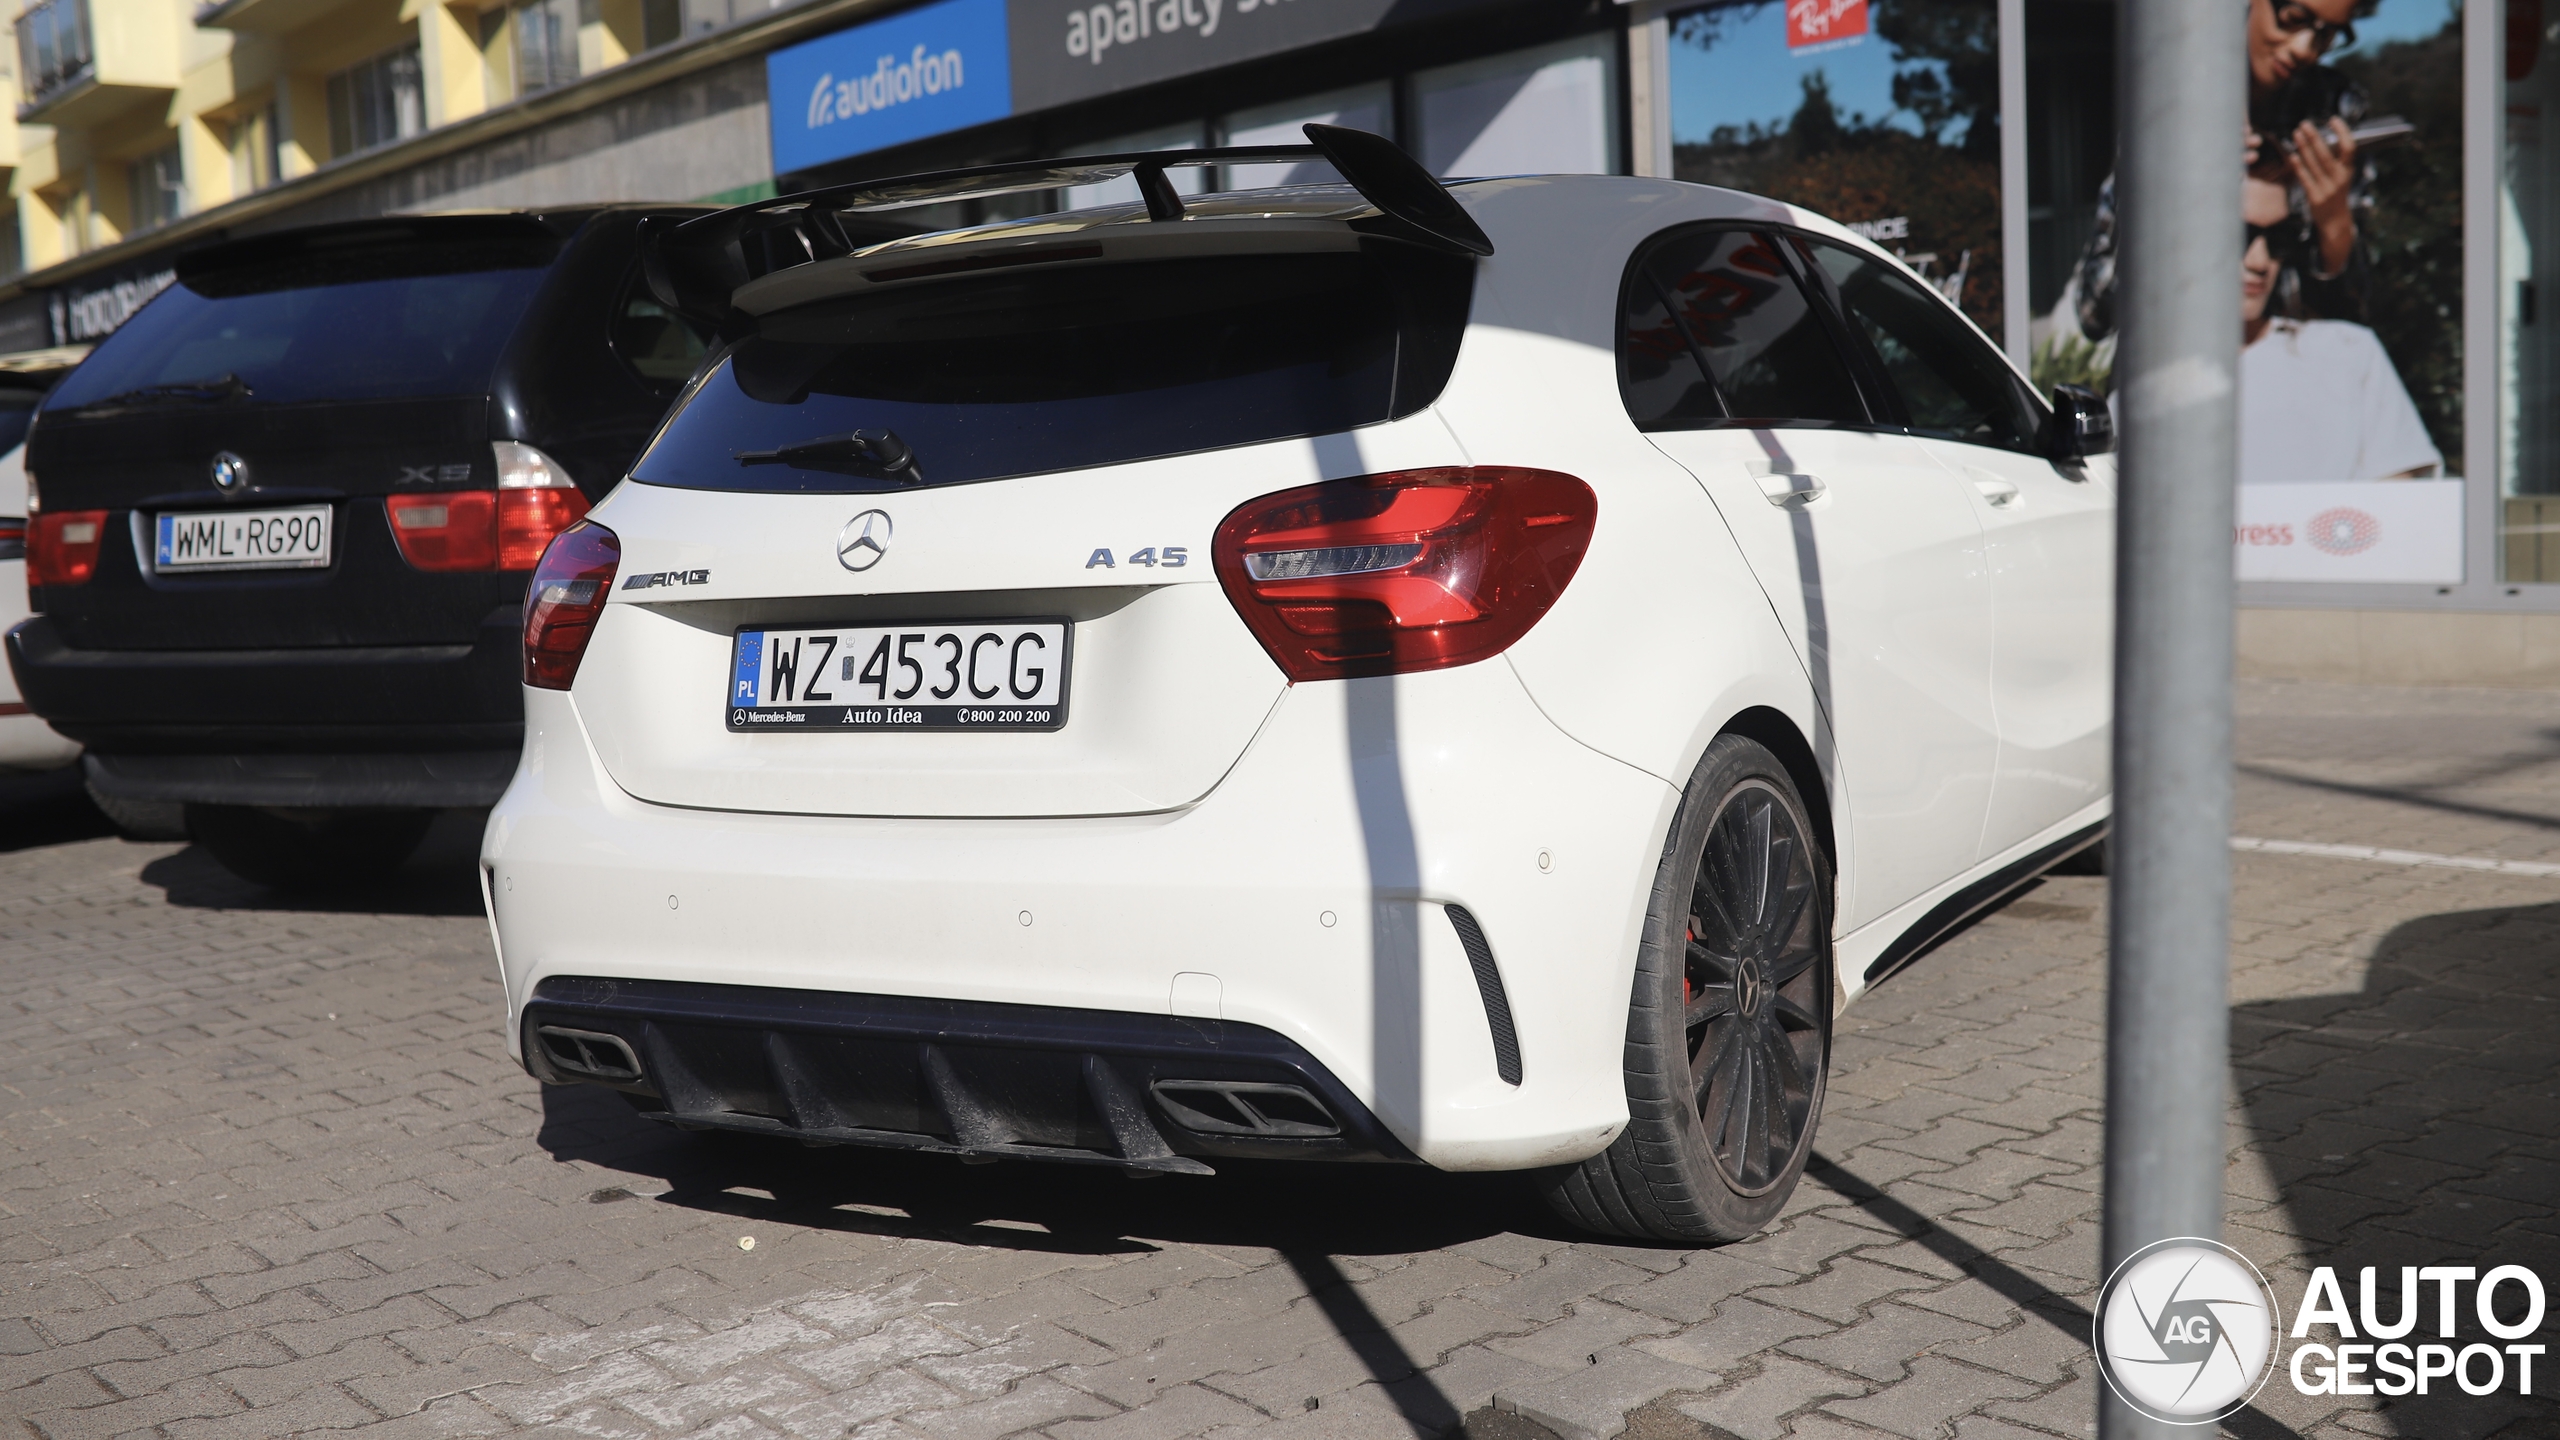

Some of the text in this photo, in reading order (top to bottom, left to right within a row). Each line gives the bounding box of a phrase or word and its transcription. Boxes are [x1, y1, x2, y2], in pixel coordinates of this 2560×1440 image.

[836, 44, 963, 120] audiofon
[177, 516, 321, 557] WML RG90
[1085, 547, 1188, 569] A 45
[770, 632, 1047, 702] WZ 453CG
[738, 680, 756, 698] PL
[747, 707, 1051, 724] Mercedes-Benz Auto Idea 800 200 200
